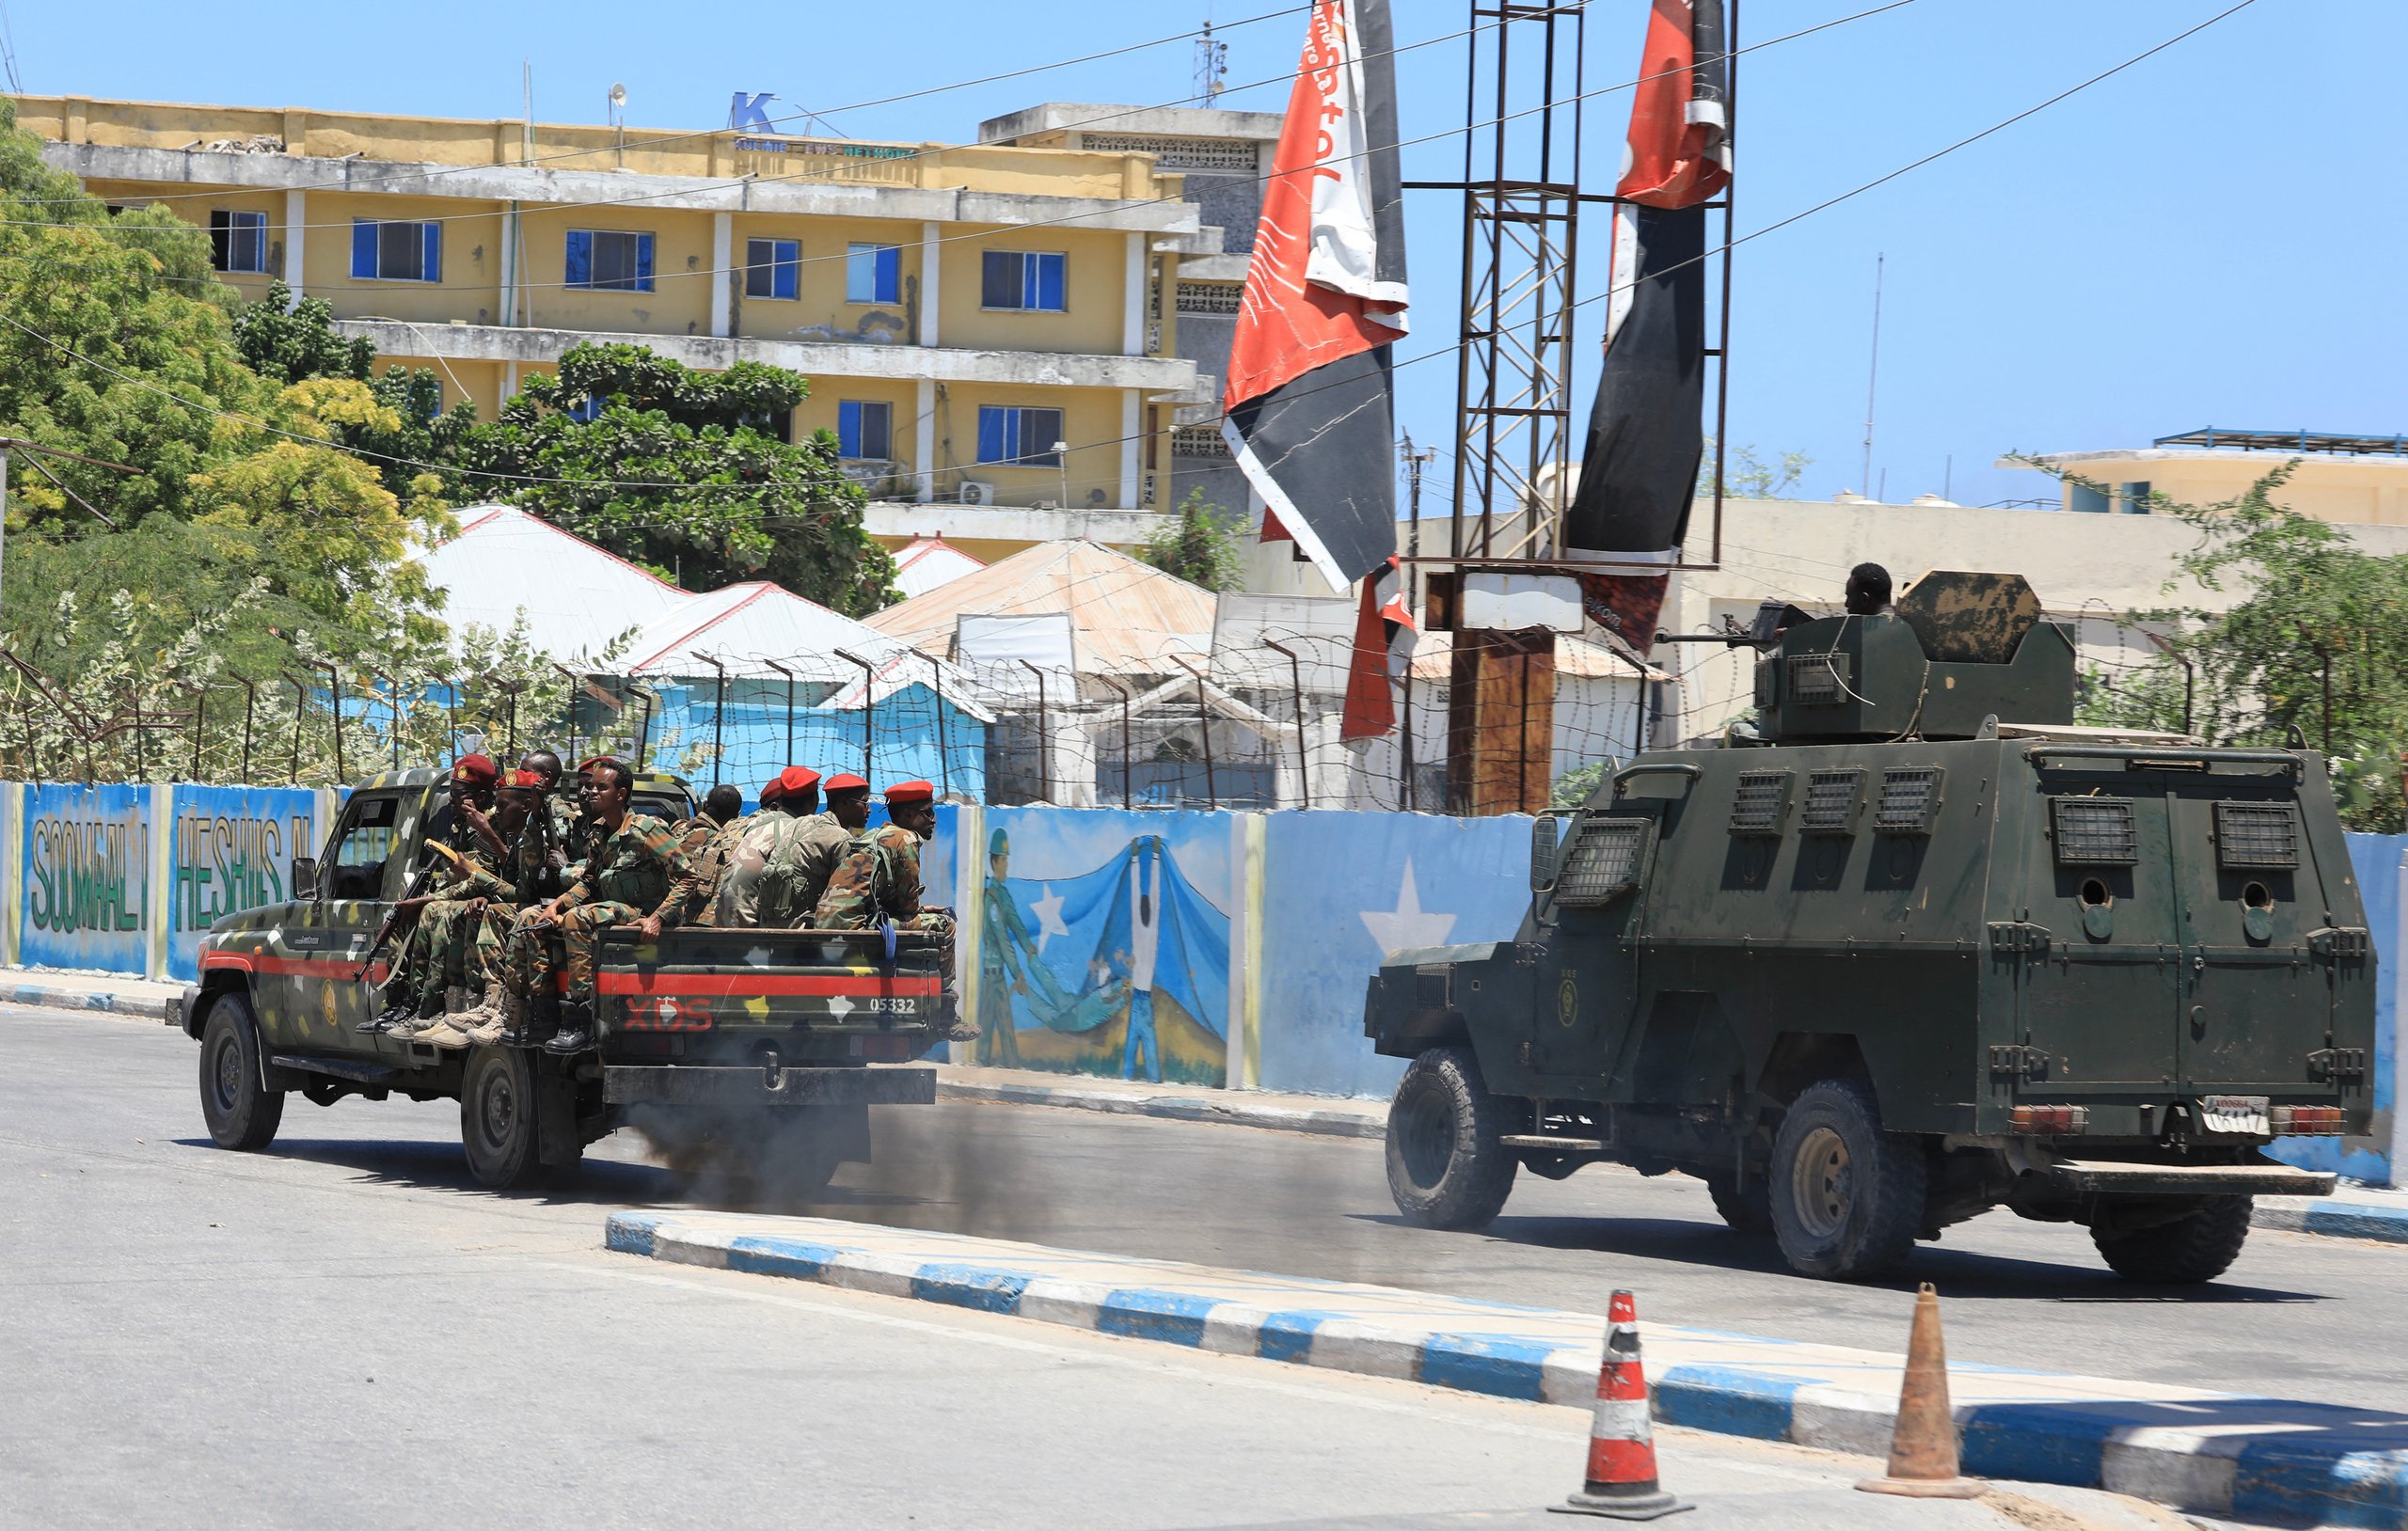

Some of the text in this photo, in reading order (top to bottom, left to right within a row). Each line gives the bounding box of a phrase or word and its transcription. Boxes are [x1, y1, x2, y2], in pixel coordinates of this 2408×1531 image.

[734, 91, 775, 134] K
[843, 145, 916, 161] NETWORK
[625, 997, 712, 1032] XDS
[869, 998, 915, 1014] 05332
